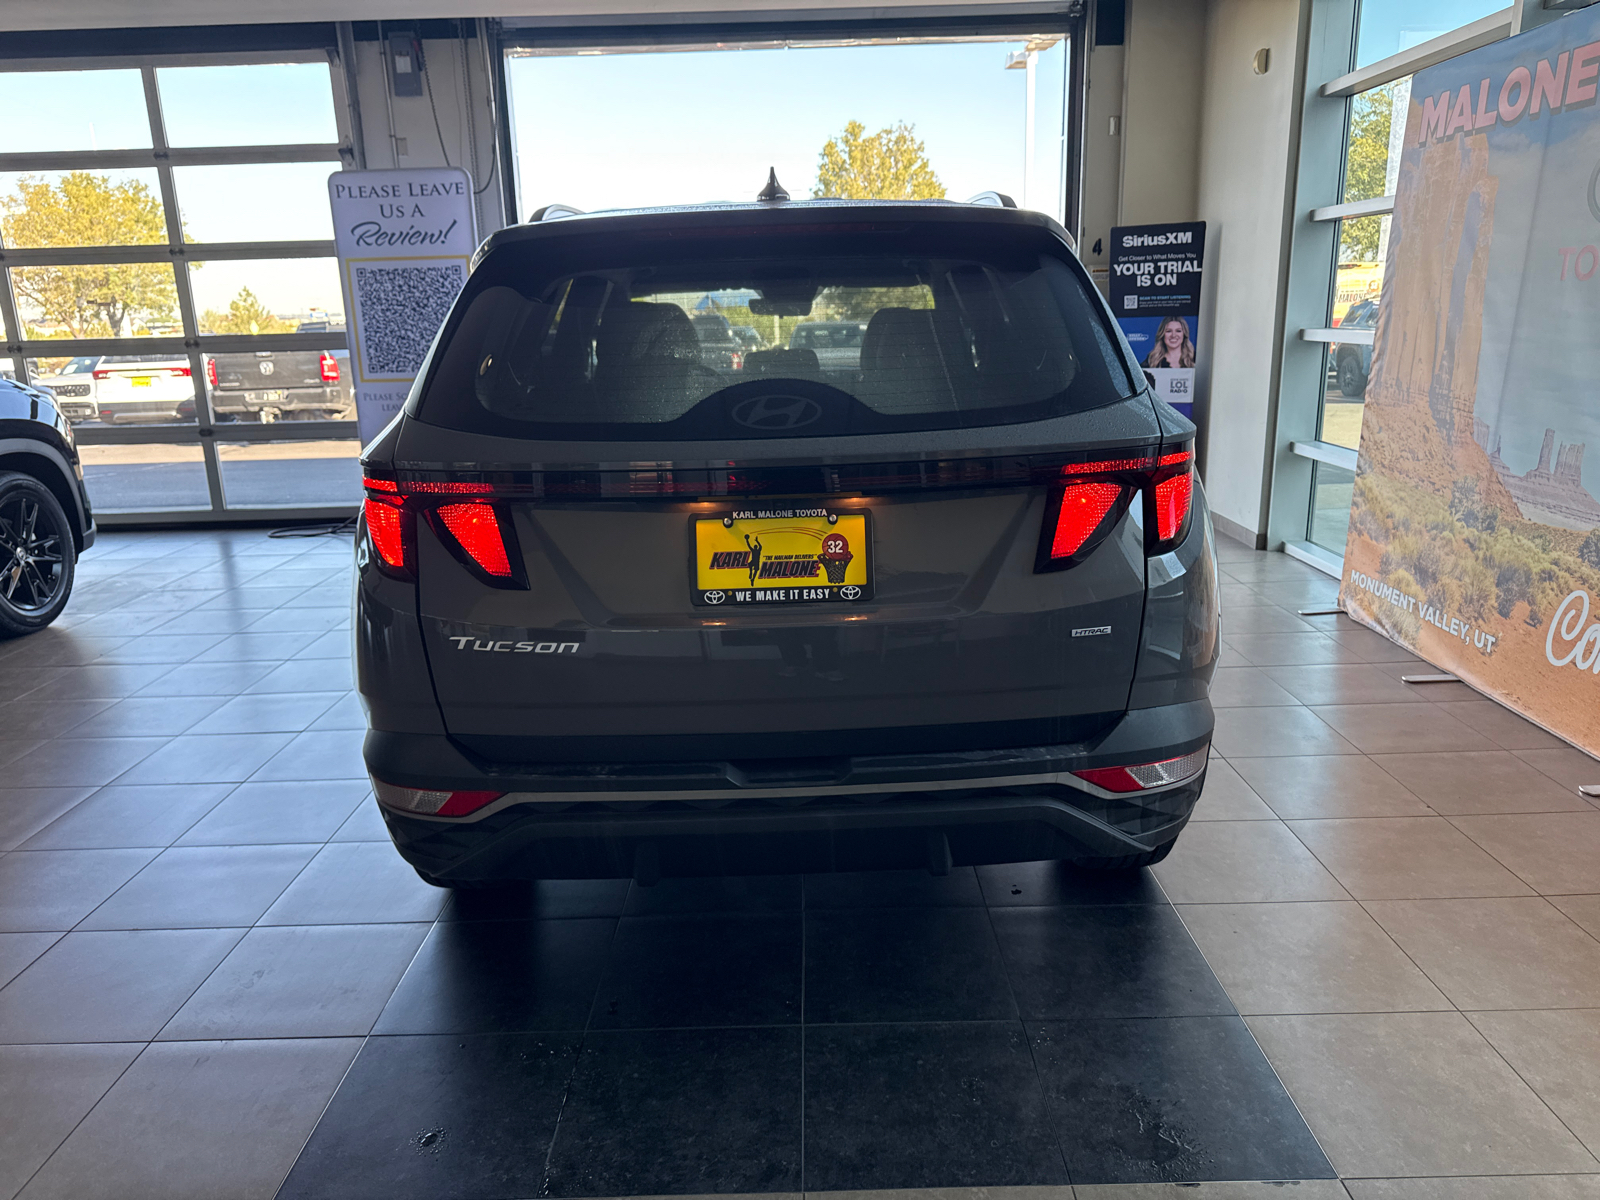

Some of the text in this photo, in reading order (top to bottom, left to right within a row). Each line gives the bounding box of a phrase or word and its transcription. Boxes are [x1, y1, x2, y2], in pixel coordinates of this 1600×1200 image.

[1418, 40, 1600, 147] MALONE
[335, 181, 465, 199] PLEASE LEAVE
[410, 203, 425, 218] A
[350, 219, 458, 247] Review!
[1122, 231, 1193, 248] SiriusXM
[1092, 237, 1103, 256] 4
[1113, 262, 1155, 276] YOUR
[1157, 260, 1202, 274] TRIAL
[1136, 273, 1178, 287] IS ON
[1170, 381, 1188, 389] LOL
[363, 392, 393, 401] PLEASE
[381, 403, 403, 411] LEAV
[732, 508, 828, 519] KARL MALONE TOYOTA
[827, 540, 844, 554] 32
[710, 551, 751, 570] KARL
[758, 560, 821, 579] MALONE
[736, 588, 830, 602] WE MAKE IT EASY
[1351, 569, 1415, 613] MONUMENT
[1474, 628, 1496, 653] UT
[1074, 627, 1109, 636] HTRAC
